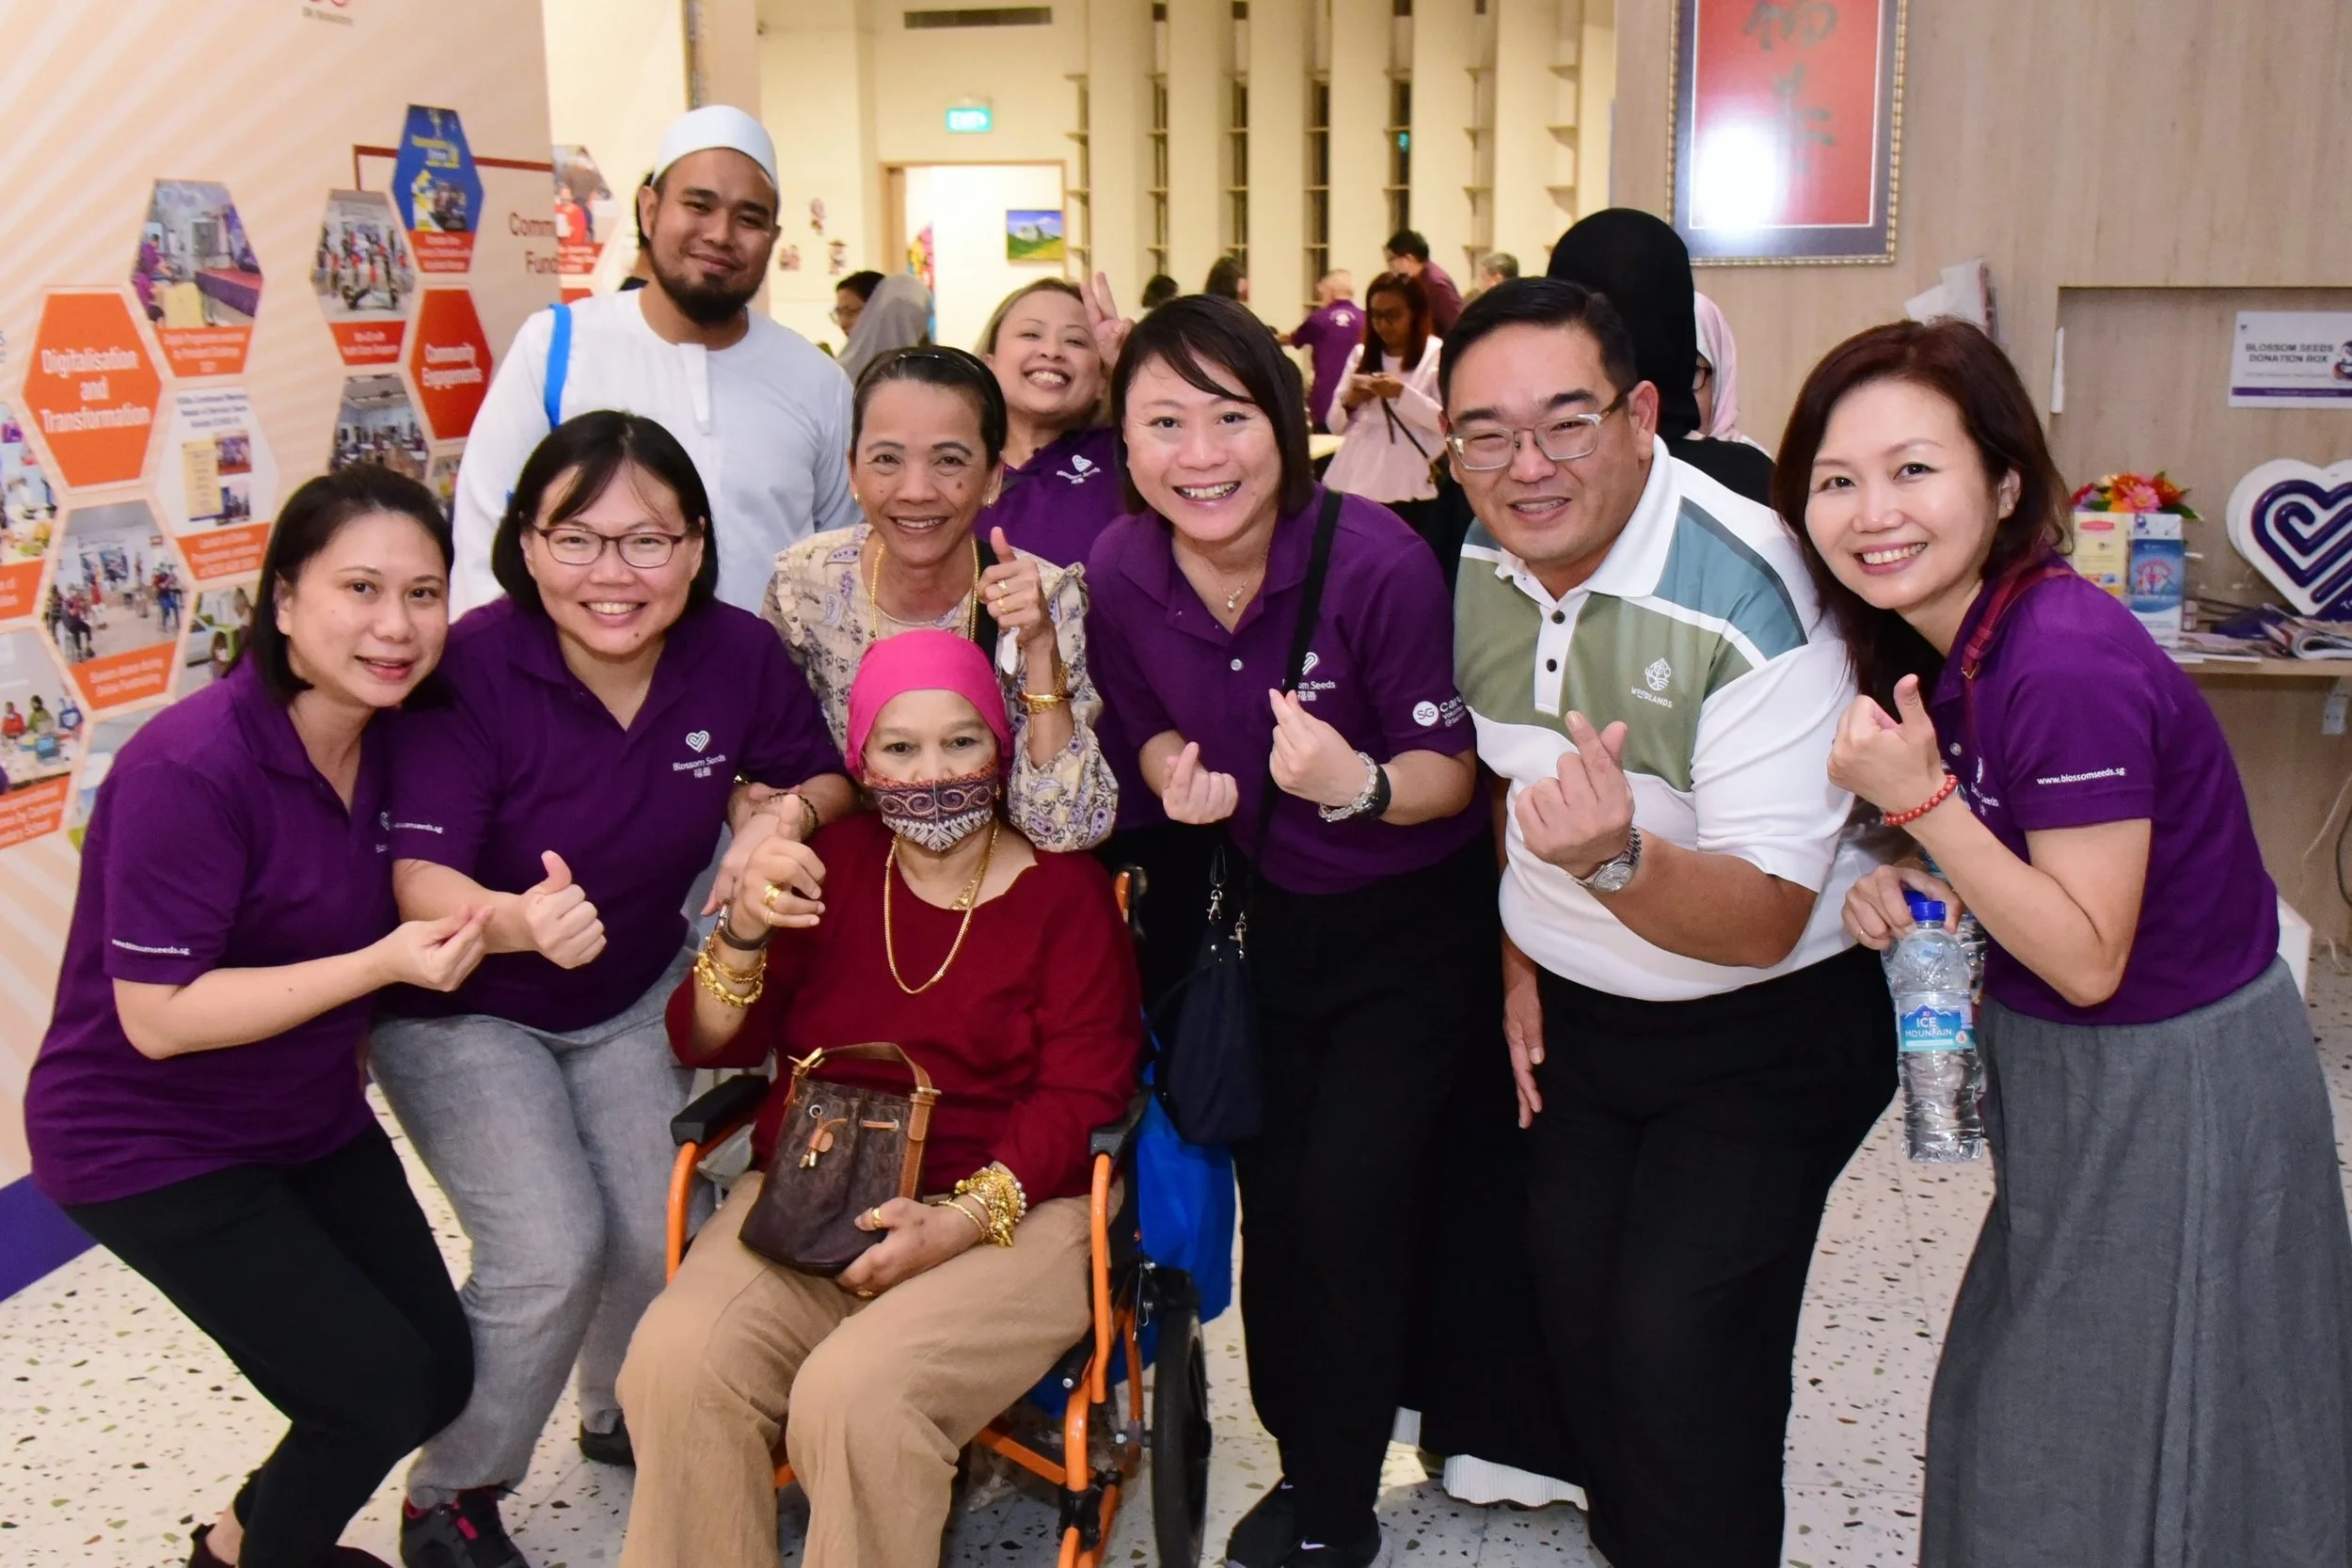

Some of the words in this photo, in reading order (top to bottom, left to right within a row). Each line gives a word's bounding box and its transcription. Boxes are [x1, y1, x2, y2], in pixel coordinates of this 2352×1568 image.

[424, 342, 476, 368] Community
[2246, 342, 2296, 353] BLOSSOM
[2299, 343, 2333, 353] SEEDS
[40, 346, 139, 379] Digitalisation
[2249, 354, 2303, 363] DONATION
[2306, 355, 2328, 363] BOX
[80, 375, 110, 401] and
[40, 402, 150, 434] Transformation
[1311, 680, 1336, 690] Seeds
[1417, 707, 1435, 721] SG
[673, 760, 705, 771] Blossom
[706, 753, 726, 766] Seeds
[2037, 767, 2126, 785] www.blossomseeds.sg
[1915, 1017, 1938, 1028] ICE
[1904, 1028, 1953, 1037] MOUNTAIN
